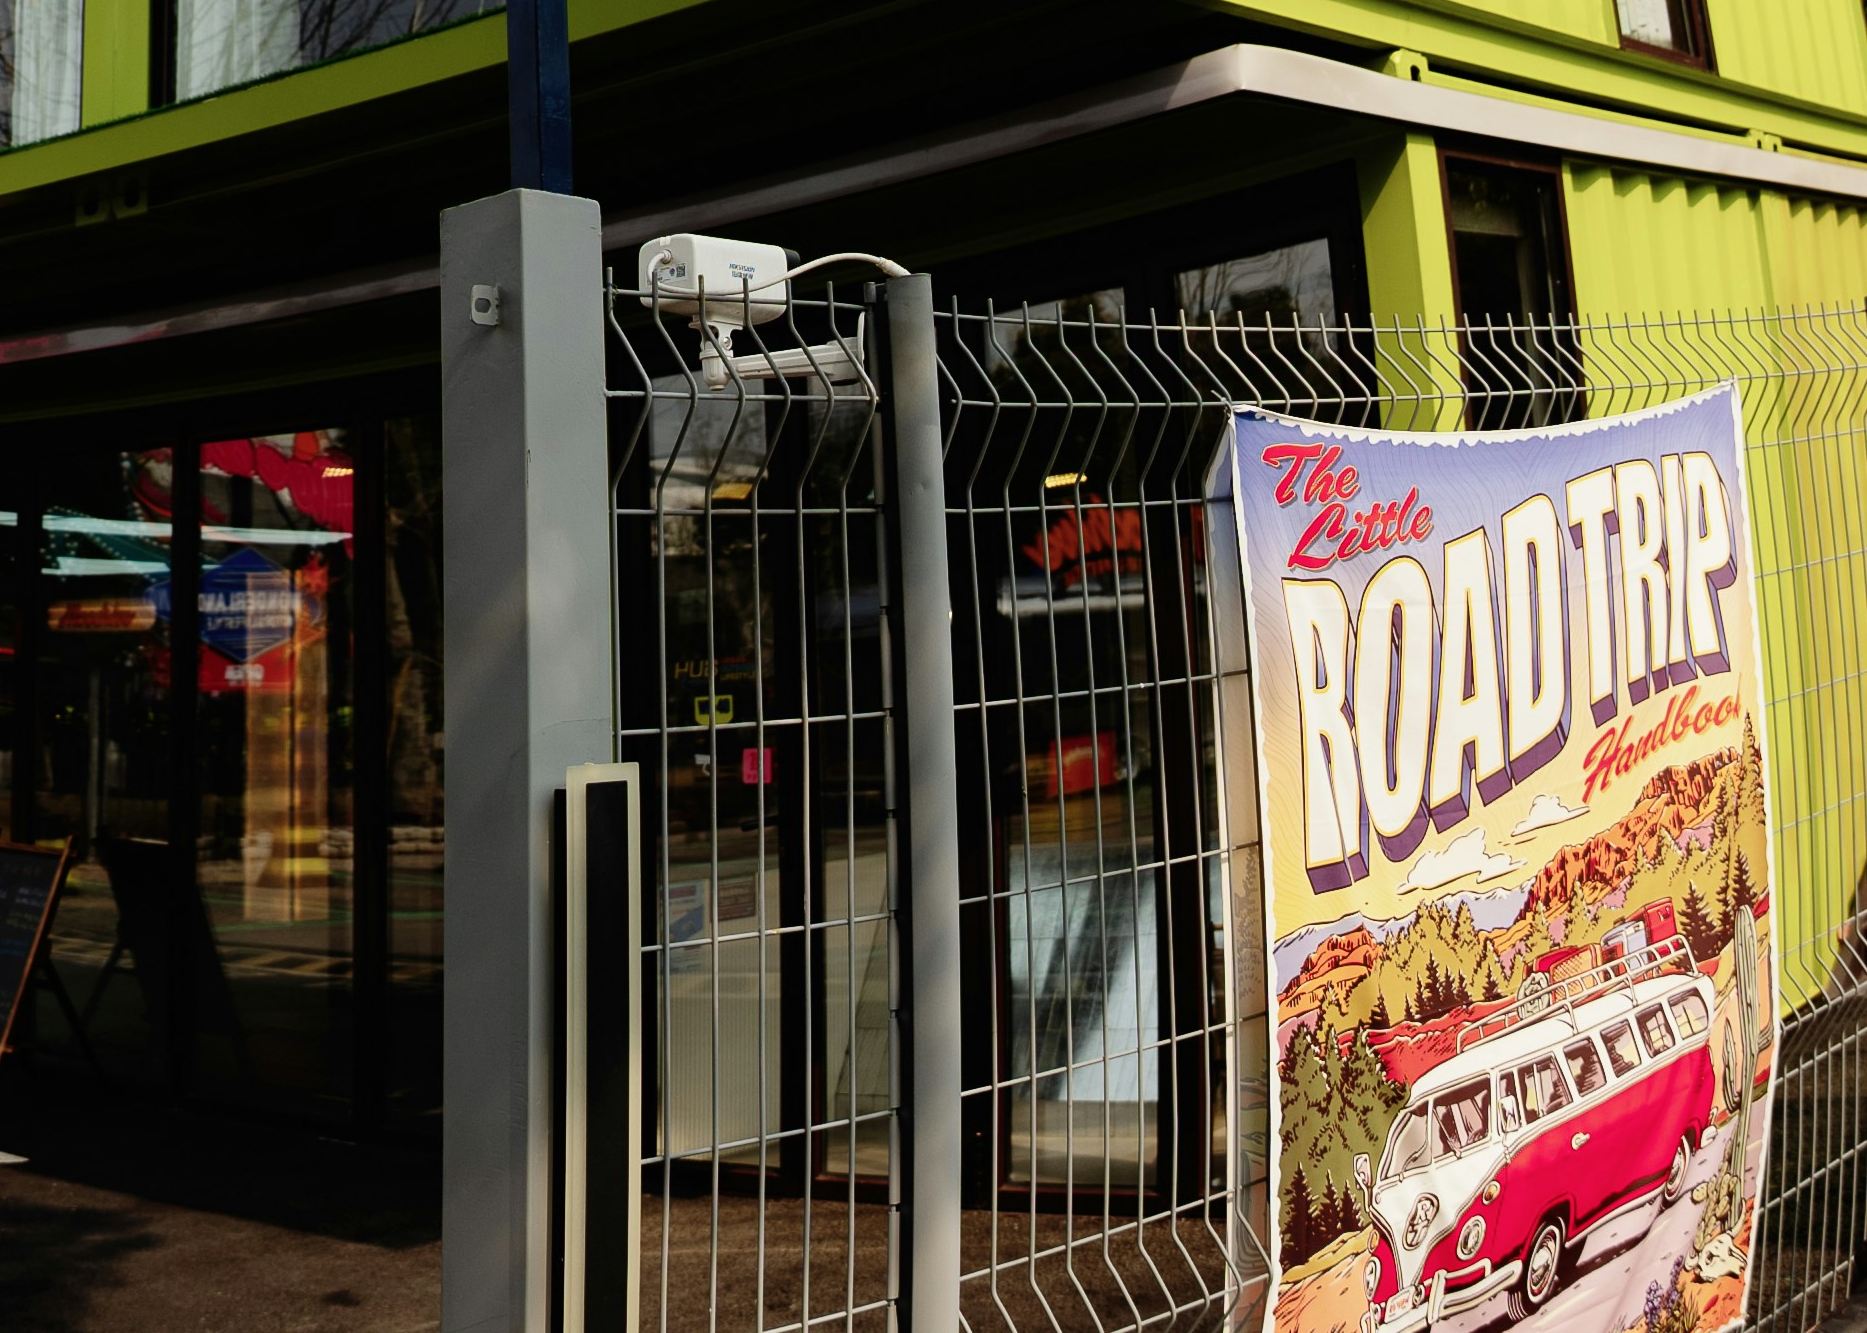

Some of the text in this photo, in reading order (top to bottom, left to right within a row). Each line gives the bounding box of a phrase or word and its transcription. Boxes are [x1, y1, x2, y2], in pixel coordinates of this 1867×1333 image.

[1261, 442, 1361, 507] The
[1286, 485, 1434, 572] Little
[1281, 449, 1738, 895] ROAD TRIP
